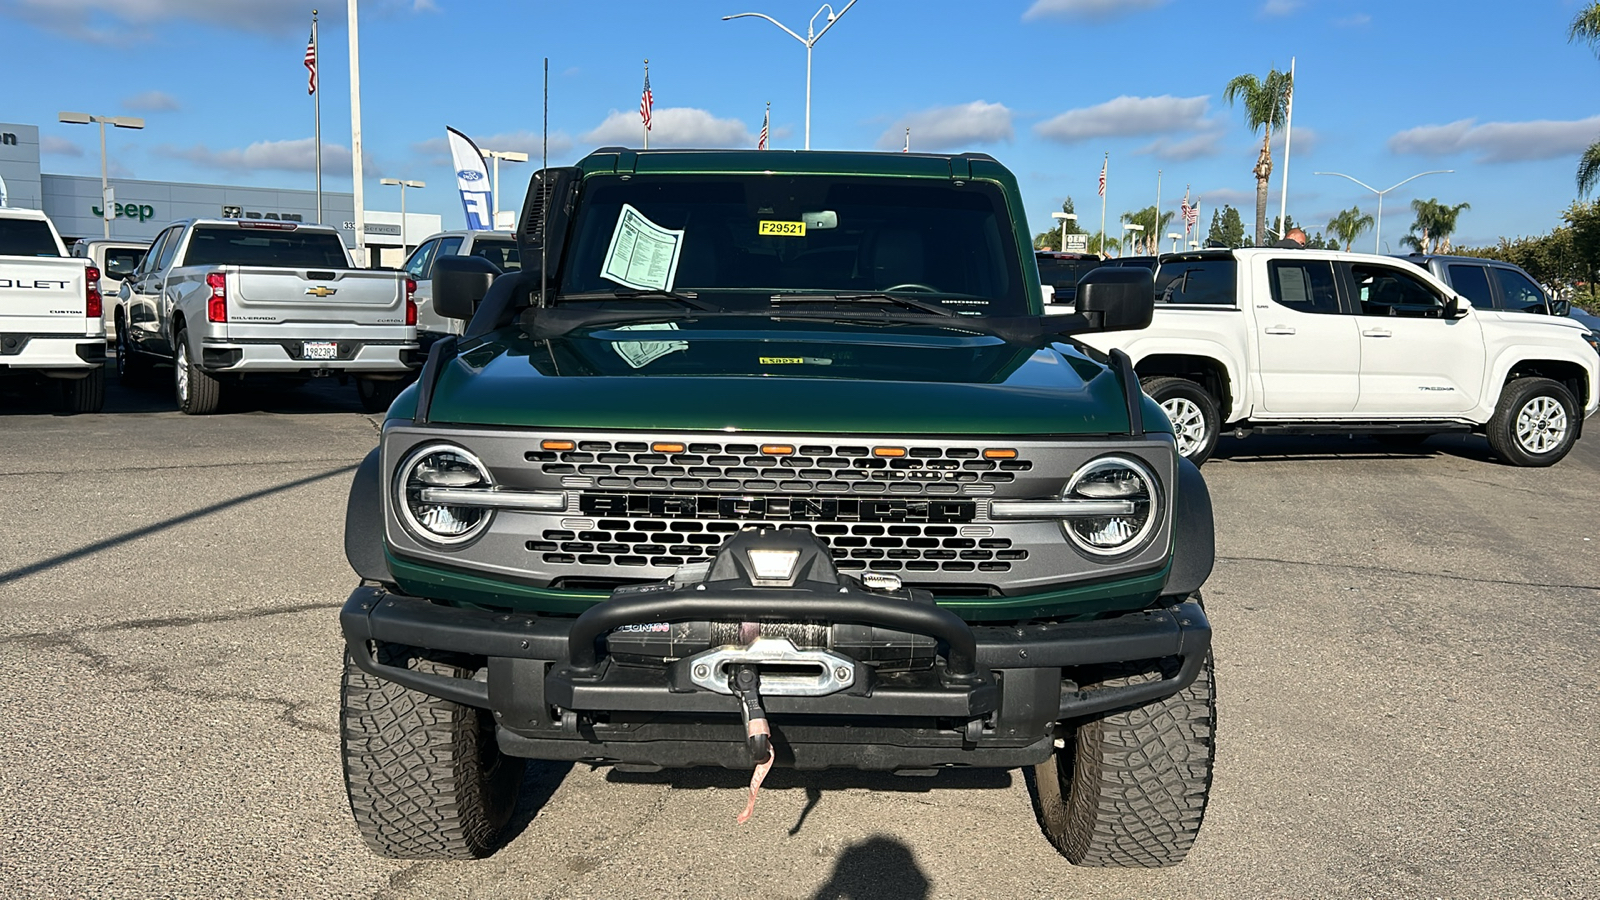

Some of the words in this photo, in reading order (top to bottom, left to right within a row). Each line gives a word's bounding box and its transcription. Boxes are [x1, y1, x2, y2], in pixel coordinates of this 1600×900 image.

[92, 202, 154, 221] Jeep
[364, 225, 396, 233] Service
[761, 222, 803, 234] F29521
